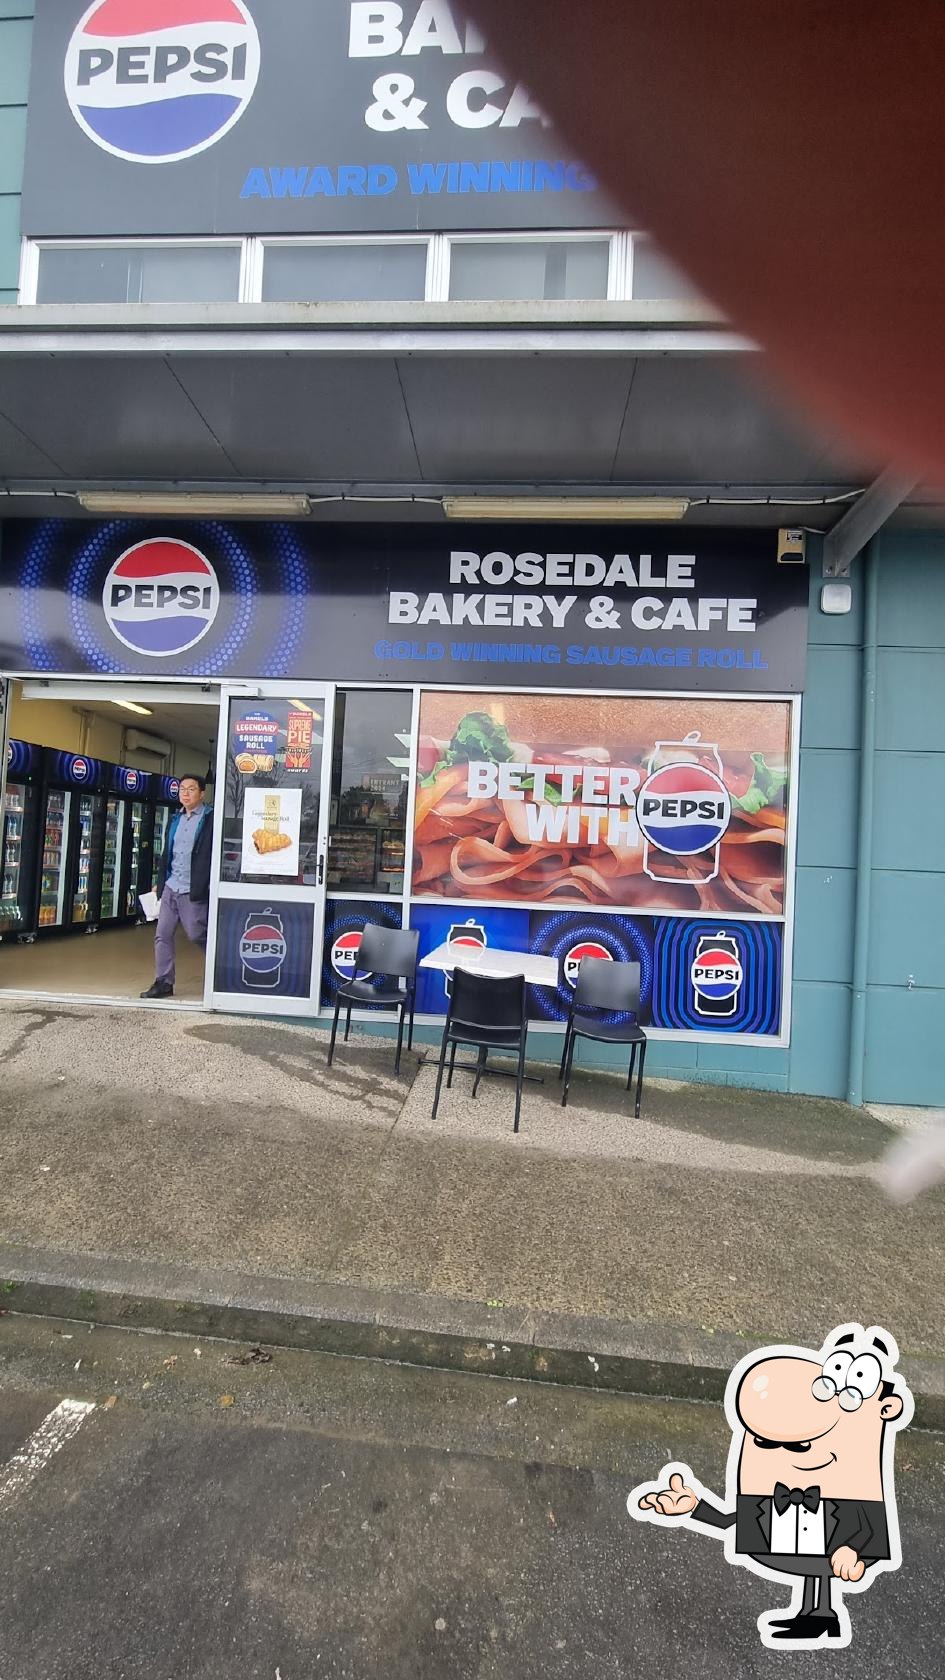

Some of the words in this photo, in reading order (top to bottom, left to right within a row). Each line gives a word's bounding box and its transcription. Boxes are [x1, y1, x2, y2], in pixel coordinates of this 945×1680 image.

[77, 42, 248, 86] PEPSI
[364, 72, 430, 132] &
[240, 164, 398, 198] AWARD
[407, 160, 597, 195] WINNING
[449, 551, 697, 588] ROSEDALE
[110, 584, 212, 610] PEPSI
[388, 591, 578, 628] BAKERY
[584, 595, 621, 630] &
[631, 597, 758, 632] CAFE
[373, 639, 445, 662] GOLD
[450, 642, 562, 665] WINNING
[566, 644, 695, 668] SAUSAGE
[697, 647, 768, 670] ROLL
[236, 723, 277, 733] LEGENDARY
[239, 735, 273, 743] SAUSAGE
[287, 731, 311, 743] PIE
[467, 761, 641, 806] BETTER
[525, 803, 639, 847] WITH
[642, 799, 725, 820] PEPSI
[242, 943, 284, 954] PEPSI
[694, 968, 739, 980] PEPSI
